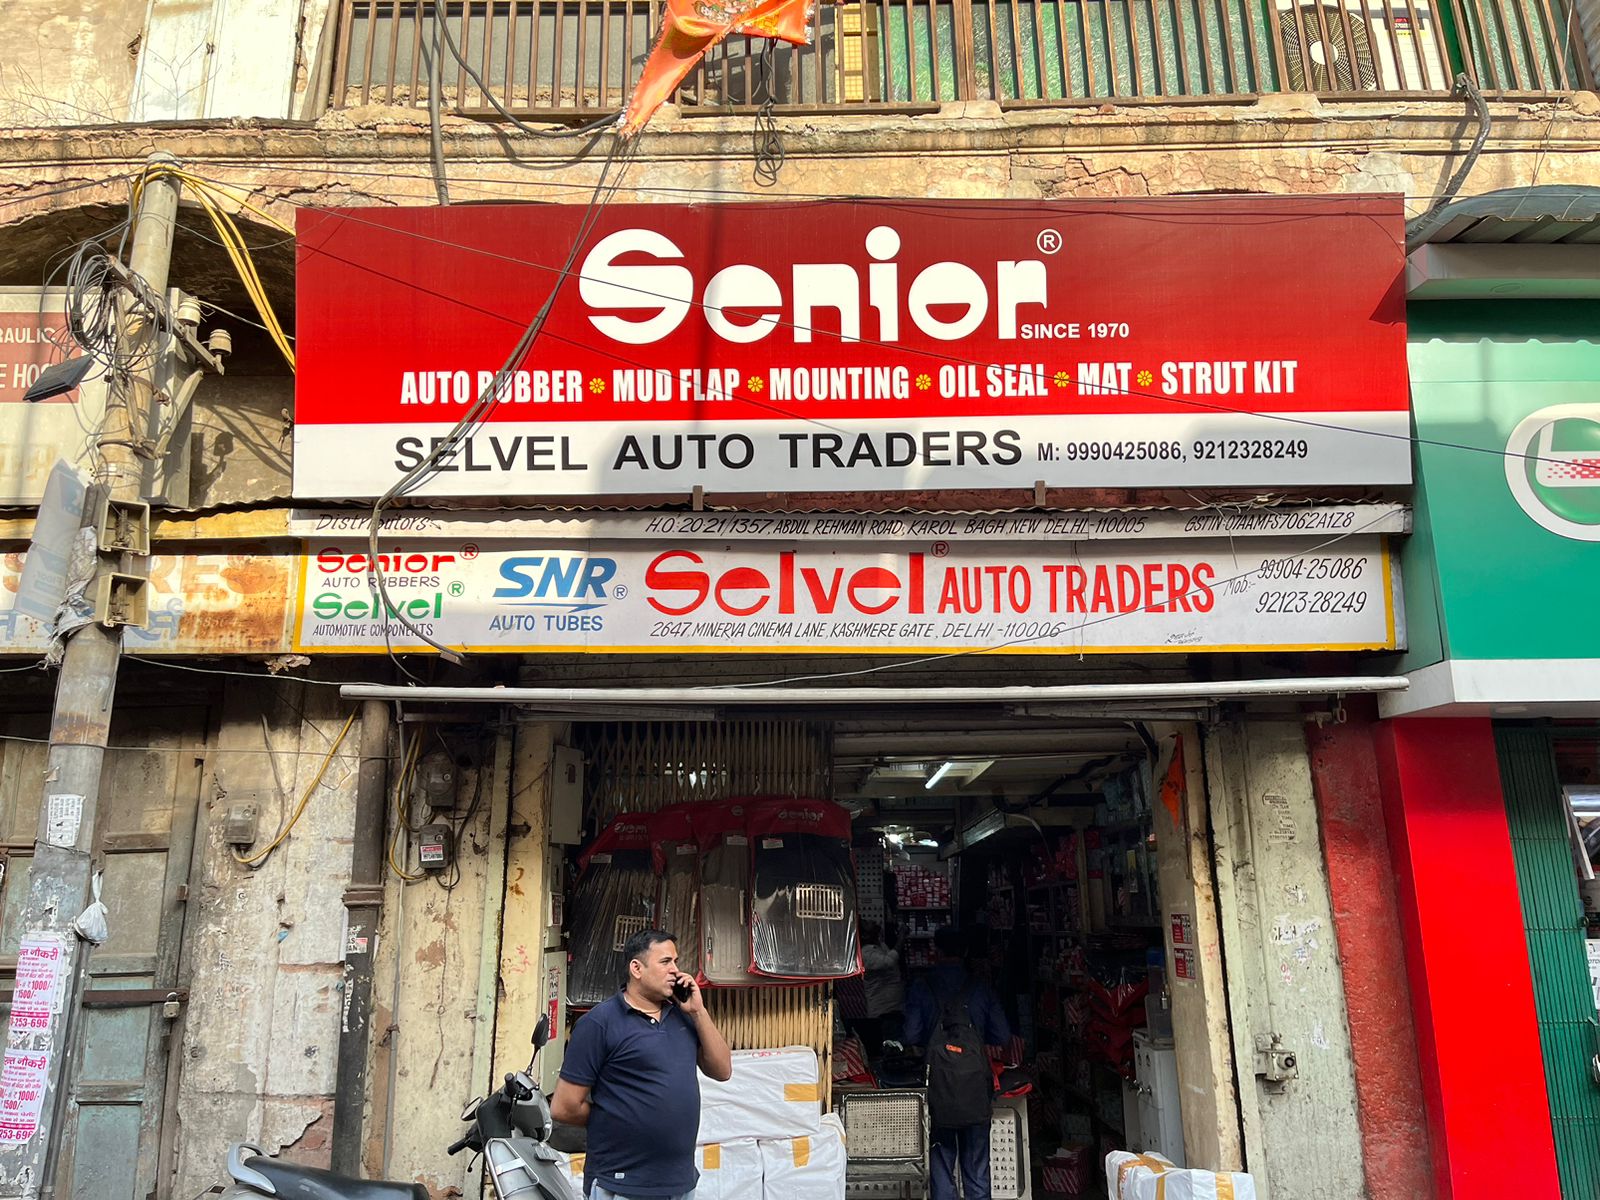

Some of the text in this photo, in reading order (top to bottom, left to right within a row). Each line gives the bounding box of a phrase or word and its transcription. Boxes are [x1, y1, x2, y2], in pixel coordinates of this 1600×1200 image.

[579, 225, 1047, 345] Senior
[1020, 323, 1130, 339] SINCE 1970
[400, 370, 470, 405] AUTO
[614, 368, 672, 403] MUD
[679, 367, 741, 403] FLAP
[769, 365, 910, 402] MOUNTING
[939, 364, 980, 398] OIL
[986, 363, 1048, 397] SEAL
[1077, 362, 1132, 396] MAT
[1161, 361, 1247, 395] STRUT
[1253, 360, 1298, 394] KIT
[394, 429, 1308, 473] SELVEL AUTO TRADERS M: 9990425086, 9212328249
[773, 519, 809, 535] ABDUL
[812, 519, 867, 535] REHMAN
[907, 519, 958, 536] KAROL
[1009, 518, 1042, 534] NEW
[317, 547, 455, 574] Senior
[322, 576, 361, 588] AUTO
[492, 556, 617, 598] SNR
[645, 549, 925, 616] Selvel
[937, 565, 1031, 615] AUTO
[1043, 562, 1215, 615] TRADERS
[312, 592, 443, 620] Selvel
[1255, 590, 1368, 613] 92123-28249
[313, 623, 367, 637] AUTOMOTIVE
[488, 614, 604, 632] AUTO TUBES
[692, 621, 746, 639] MINERVA
[748, 622, 792, 638] CINEMA
[829, 622, 899, 638] KASHMERE
